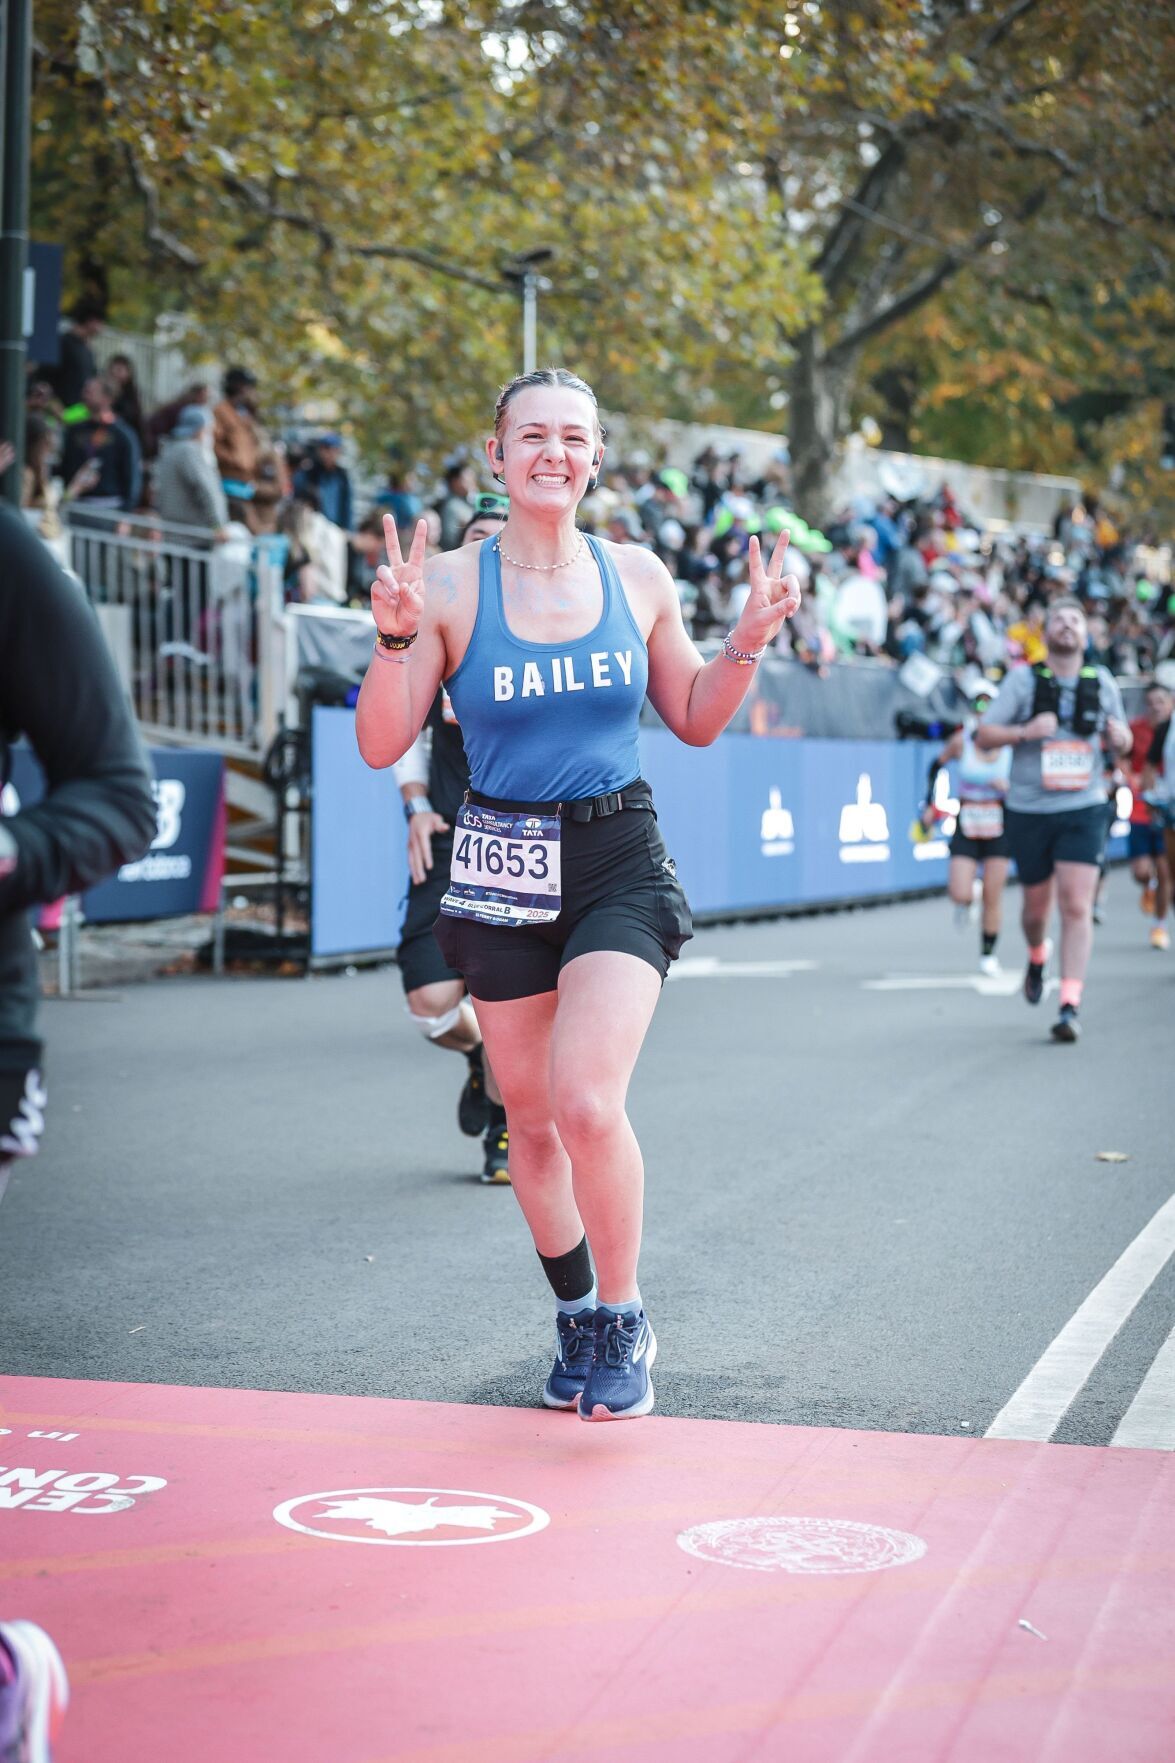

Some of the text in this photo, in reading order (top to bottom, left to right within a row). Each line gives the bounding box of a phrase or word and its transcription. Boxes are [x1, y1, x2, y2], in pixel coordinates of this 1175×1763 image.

[494, 650, 632, 702] BAILEY
[455, 833, 549, 880] 41653
[504, 906, 511, 915] B
[526, 910, 549, 918] 2025
[0, 1466, 168, 1495] CON
